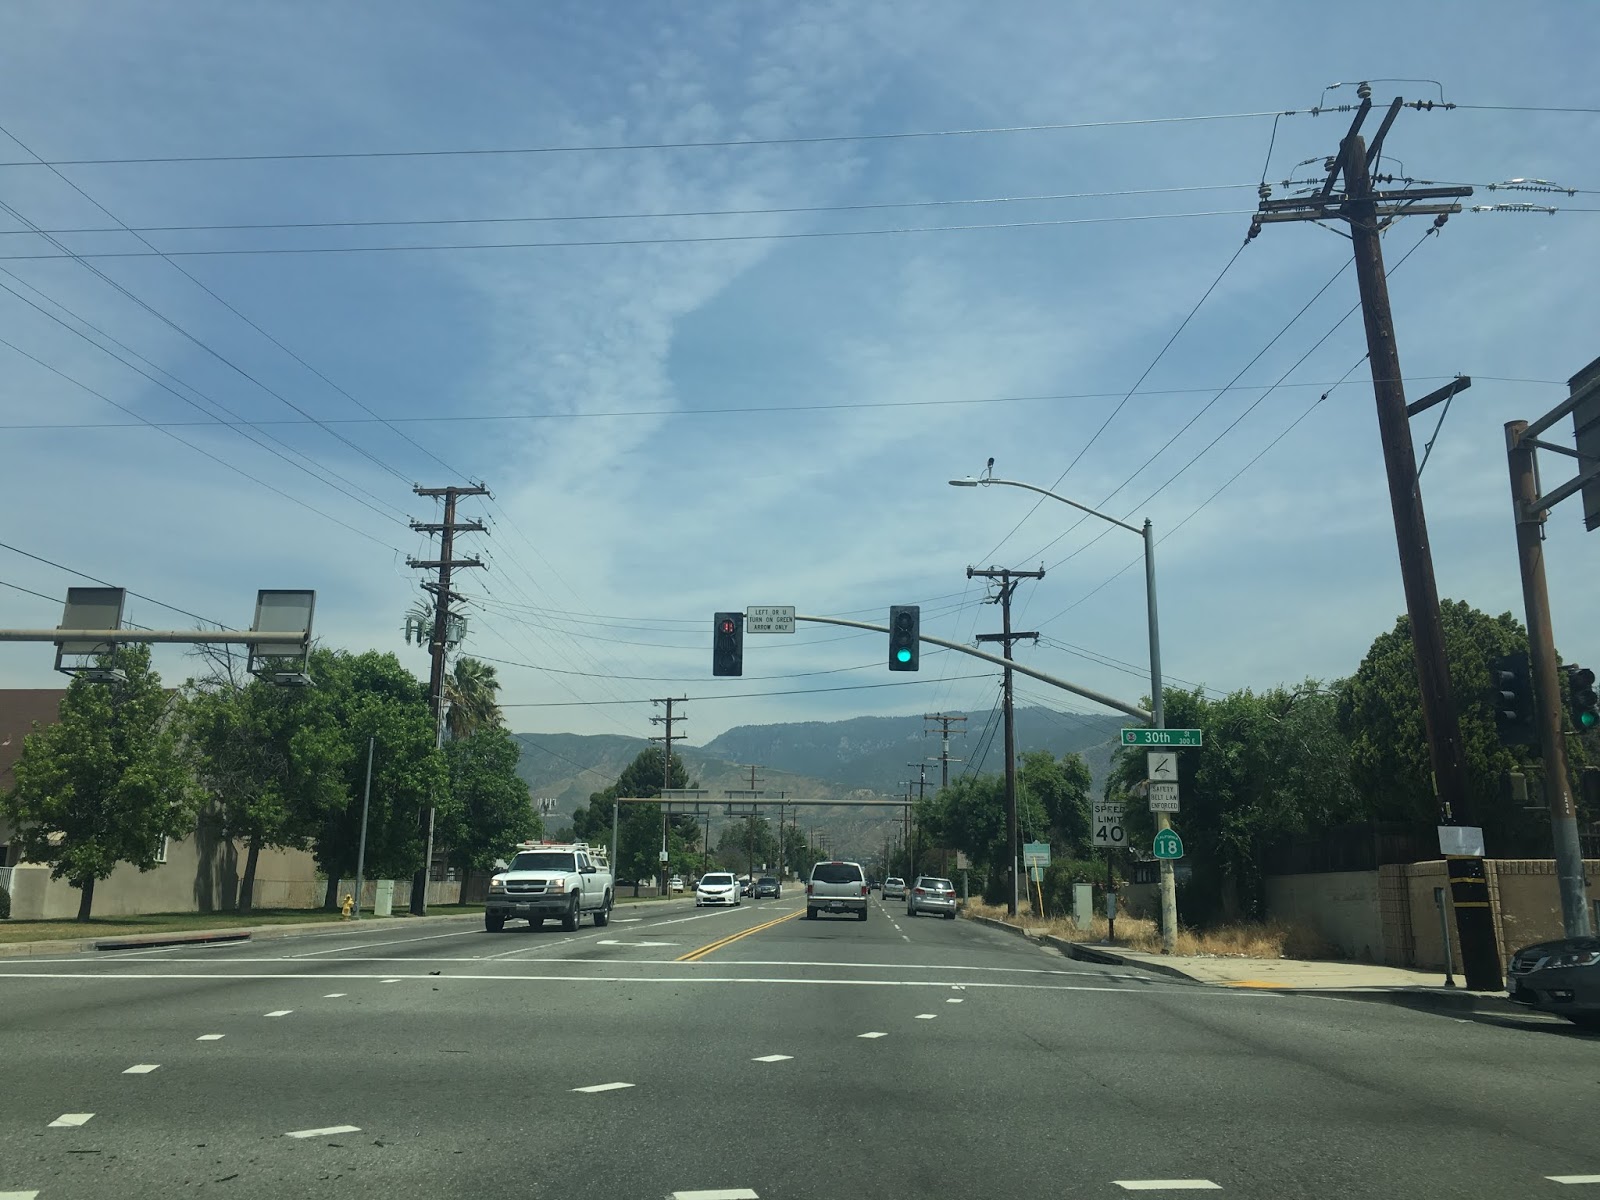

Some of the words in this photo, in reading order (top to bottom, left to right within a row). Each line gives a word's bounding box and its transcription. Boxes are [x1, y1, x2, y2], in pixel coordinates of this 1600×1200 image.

[1144, 731, 1171, 743] 30th
[1150, 793, 1163, 801] BELT
[1094, 805, 1126, 813] SPEED
[1151, 802, 1178, 810] ENFORCED
[1096, 825, 1124, 842] 40
[1159, 840, 1178, 855] 18
